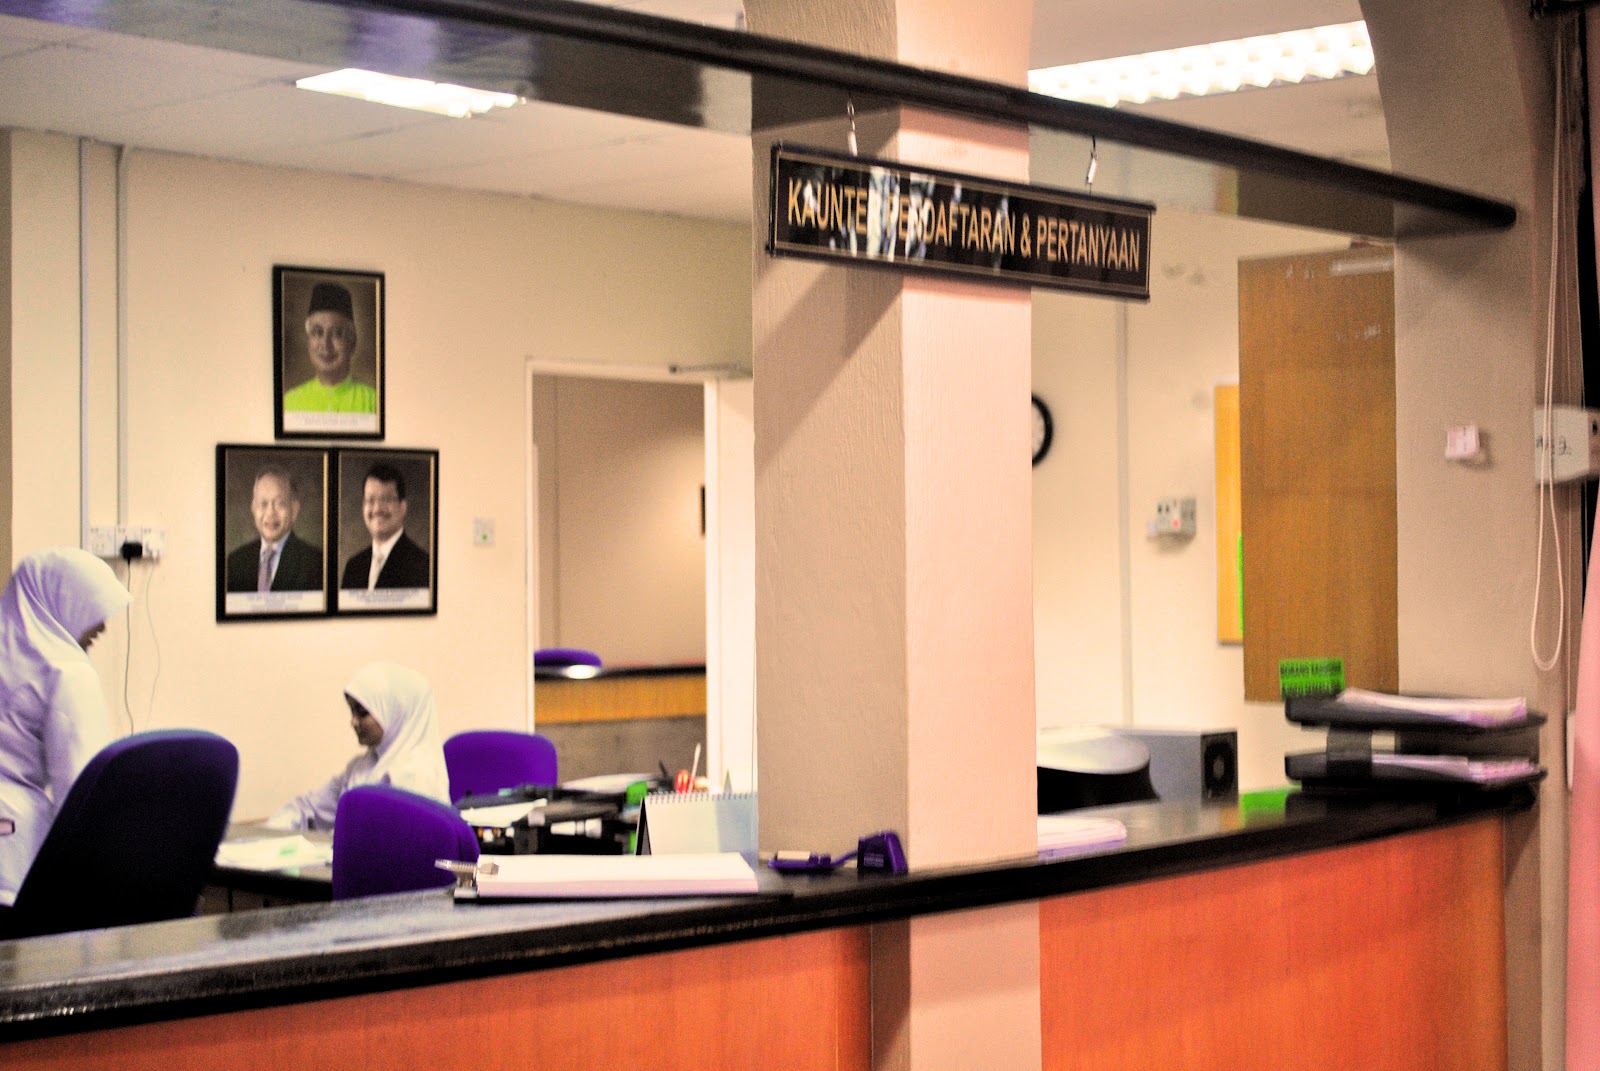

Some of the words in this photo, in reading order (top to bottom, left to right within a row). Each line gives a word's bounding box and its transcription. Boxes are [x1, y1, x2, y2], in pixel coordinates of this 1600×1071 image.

[787, 176, 882, 236] KAUNTE
[1020, 219, 1032, 257] &
[1036, 216, 1141, 272] PERTANYAAN
